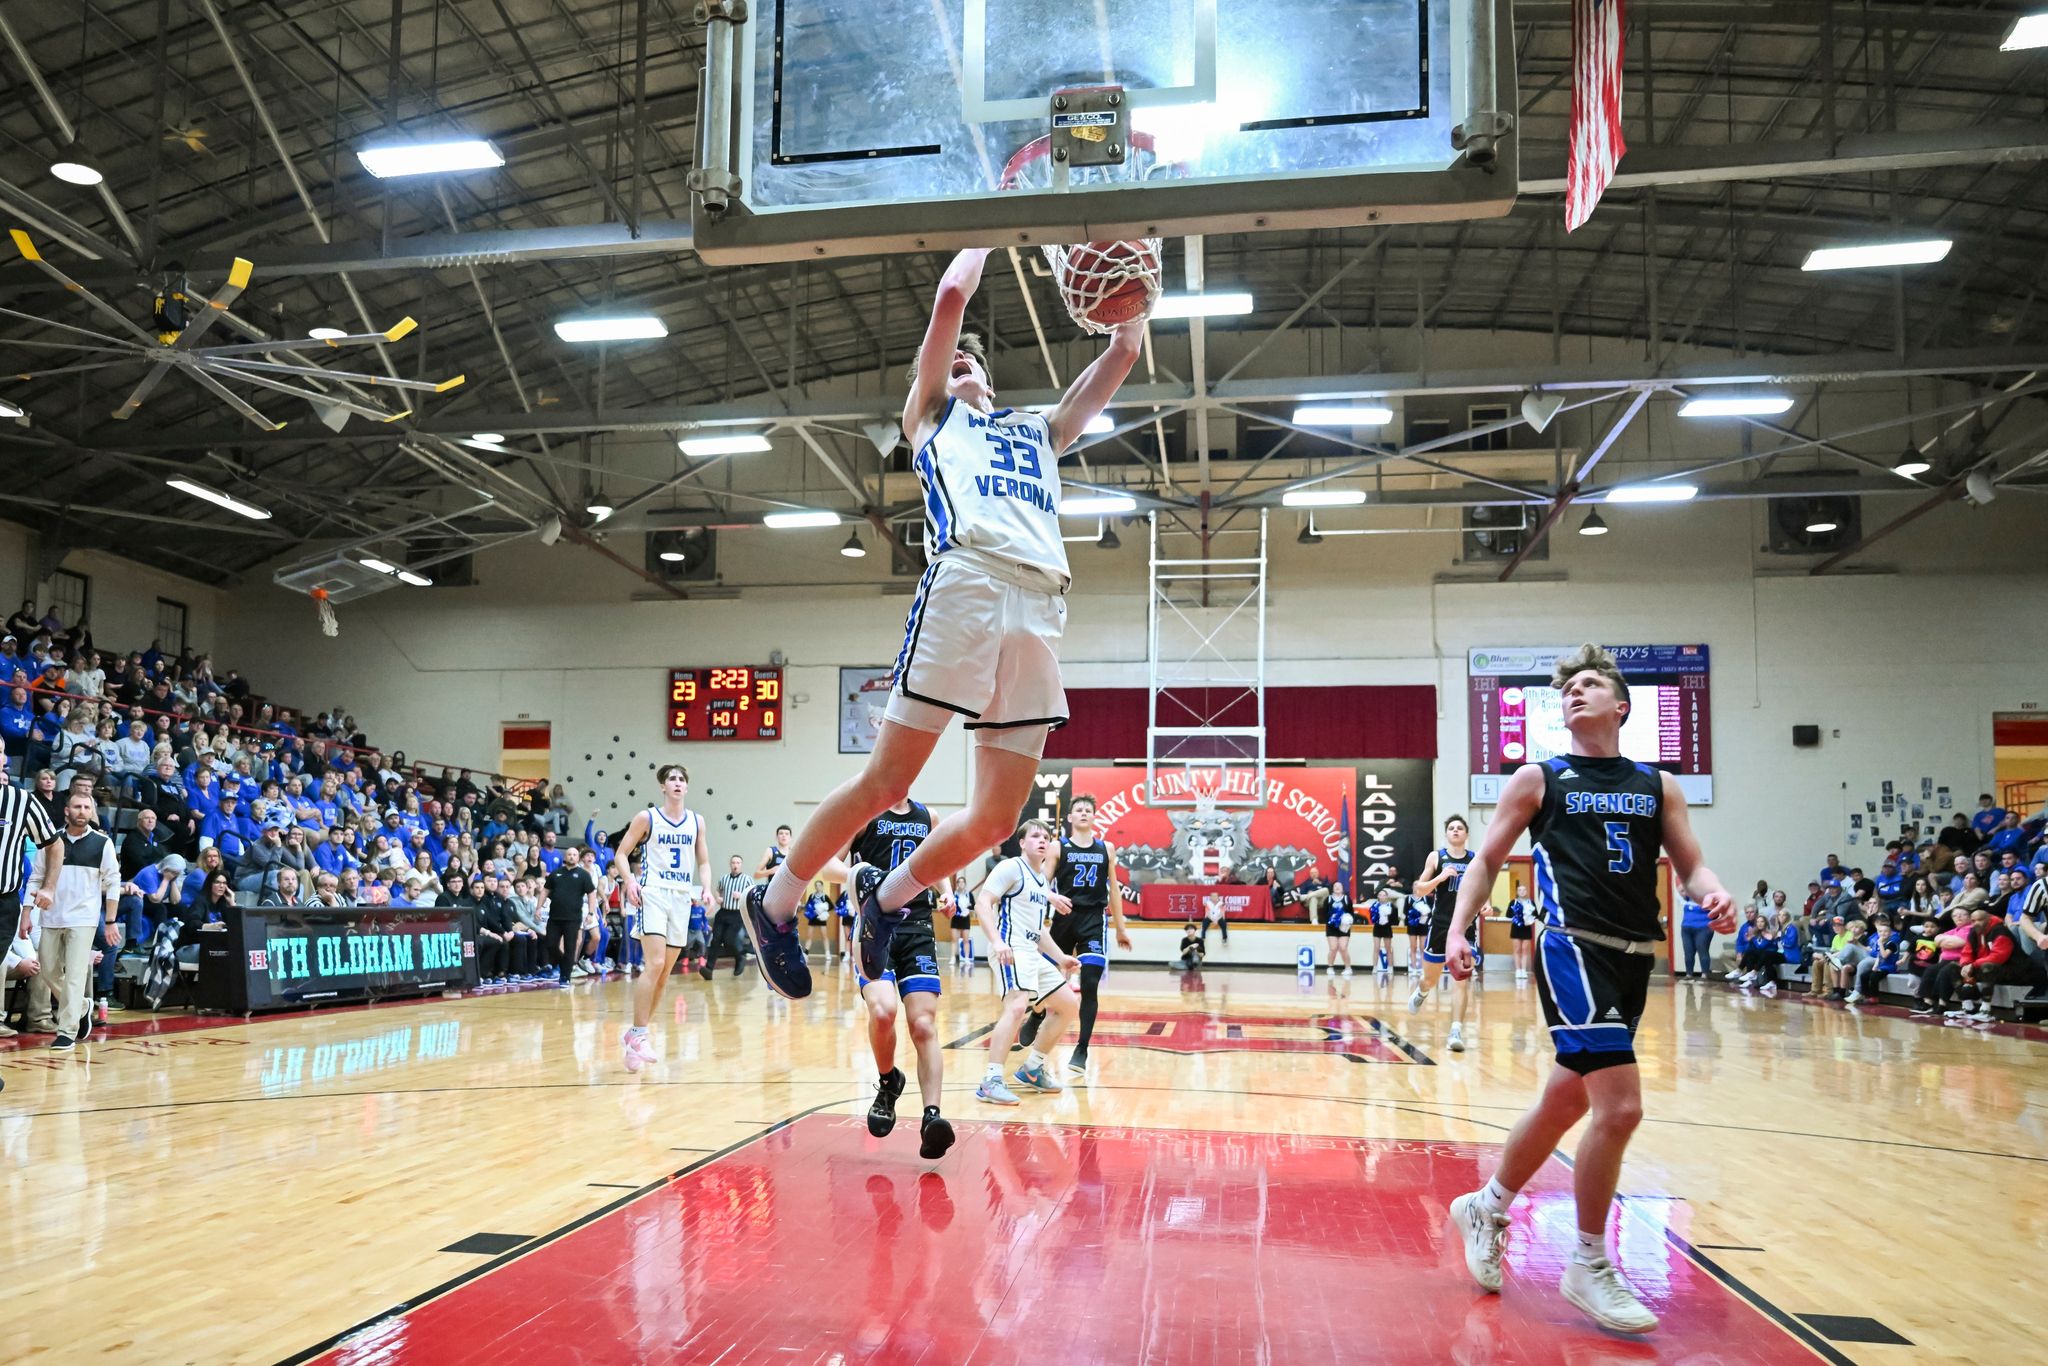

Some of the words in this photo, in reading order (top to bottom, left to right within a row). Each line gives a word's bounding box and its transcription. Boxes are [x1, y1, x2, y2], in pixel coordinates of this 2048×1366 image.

[986, 433, 1042, 479] 33
[975, 475, 1056, 515] VERONA
[1605, 646, 1649, 660] RRY'S
[710, 669, 748, 689] 2:23
[673, 681, 696, 701] 23
[756, 680, 778, 700] 30
[713, 700, 735, 708] period
[739, 695, 750, 710] 2
[675, 711, 686, 726] 2
[763, 711, 774, 726] 0
[712, 728, 734, 736] player
[1481, 693, 1489, 773] WILDCATS
[1566, 792, 1656, 818] SPENCER
[877, 820, 928, 837] SPENCER
[658, 834, 692, 845] WALTON
[1604, 822, 1633, 873] 5
[670, 848, 681, 868] 3
[659, 871, 691, 882] VERONA
[1073, 864, 1098, 887] 24
[1030, 891, 1049, 906] WALT
[1039, 909, 1043, 930] 1
[267, 938, 310, 979] TH
[317, 935, 414, 977] OLDHAM
